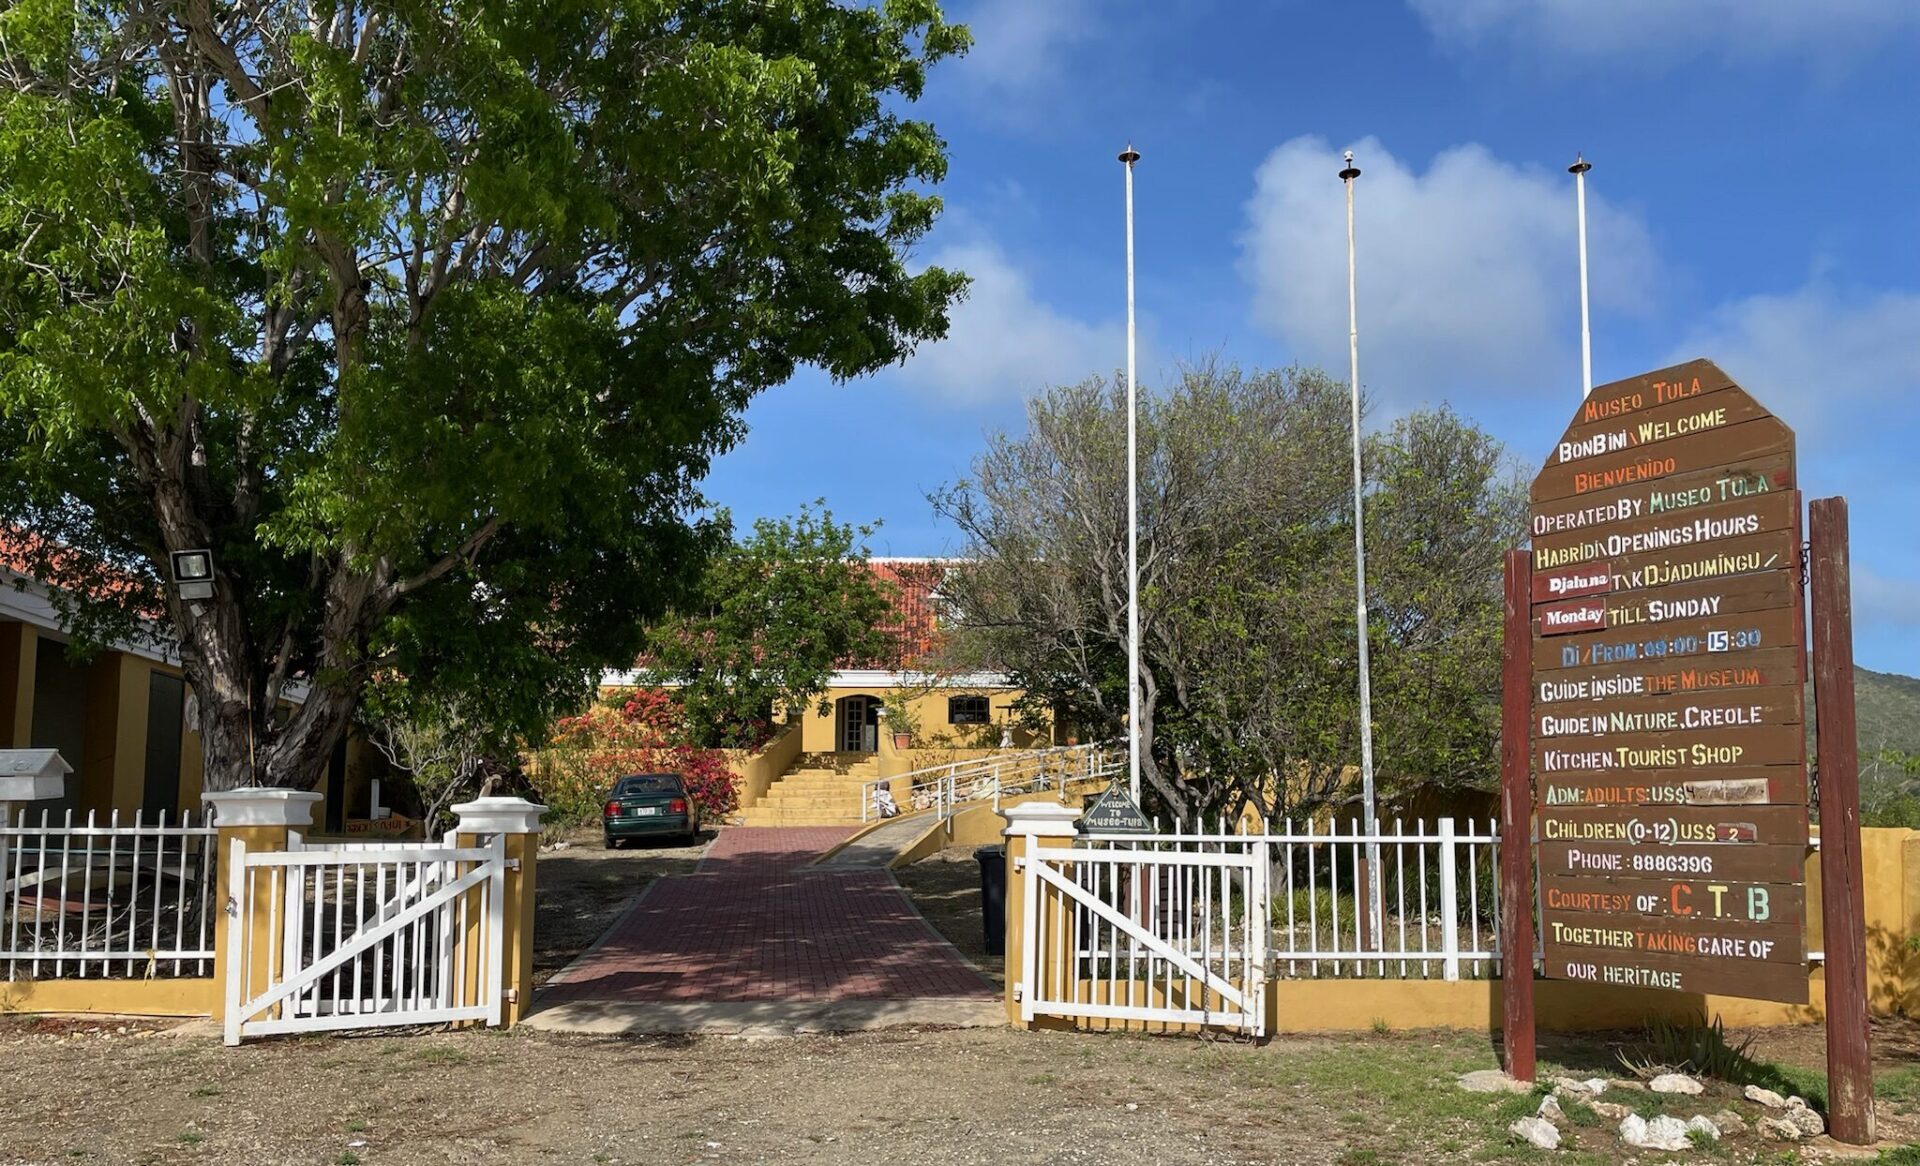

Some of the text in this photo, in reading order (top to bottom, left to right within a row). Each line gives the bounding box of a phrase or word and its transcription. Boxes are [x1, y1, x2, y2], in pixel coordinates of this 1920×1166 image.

[1584, 377, 1701, 423] MUSEO TULA
[1575, 457, 1676, 494] BIENVENIDO
[1650, 486, 1711, 514] MUSEO
[1716, 475, 1769, 501] TULA
[1547, 596, 1721, 627] Monday TILL SUNDAY
[1541, 667, 1760, 702] GUIDE INSIDE THE MUSEUM
[1542, 715, 1589, 736] GUIDE
[1593, 715, 1608, 734] IN
[1692, 743, 1743, 766] SHOP
[1109, 808, 1122, 817] TO
[1548, 888, 1631, 911] COURTESY
[1552, 922, 1775, 960] TOGETHER TAKING CARE OF
[1567, 962, 1682, 989] OUR HERITAGE
